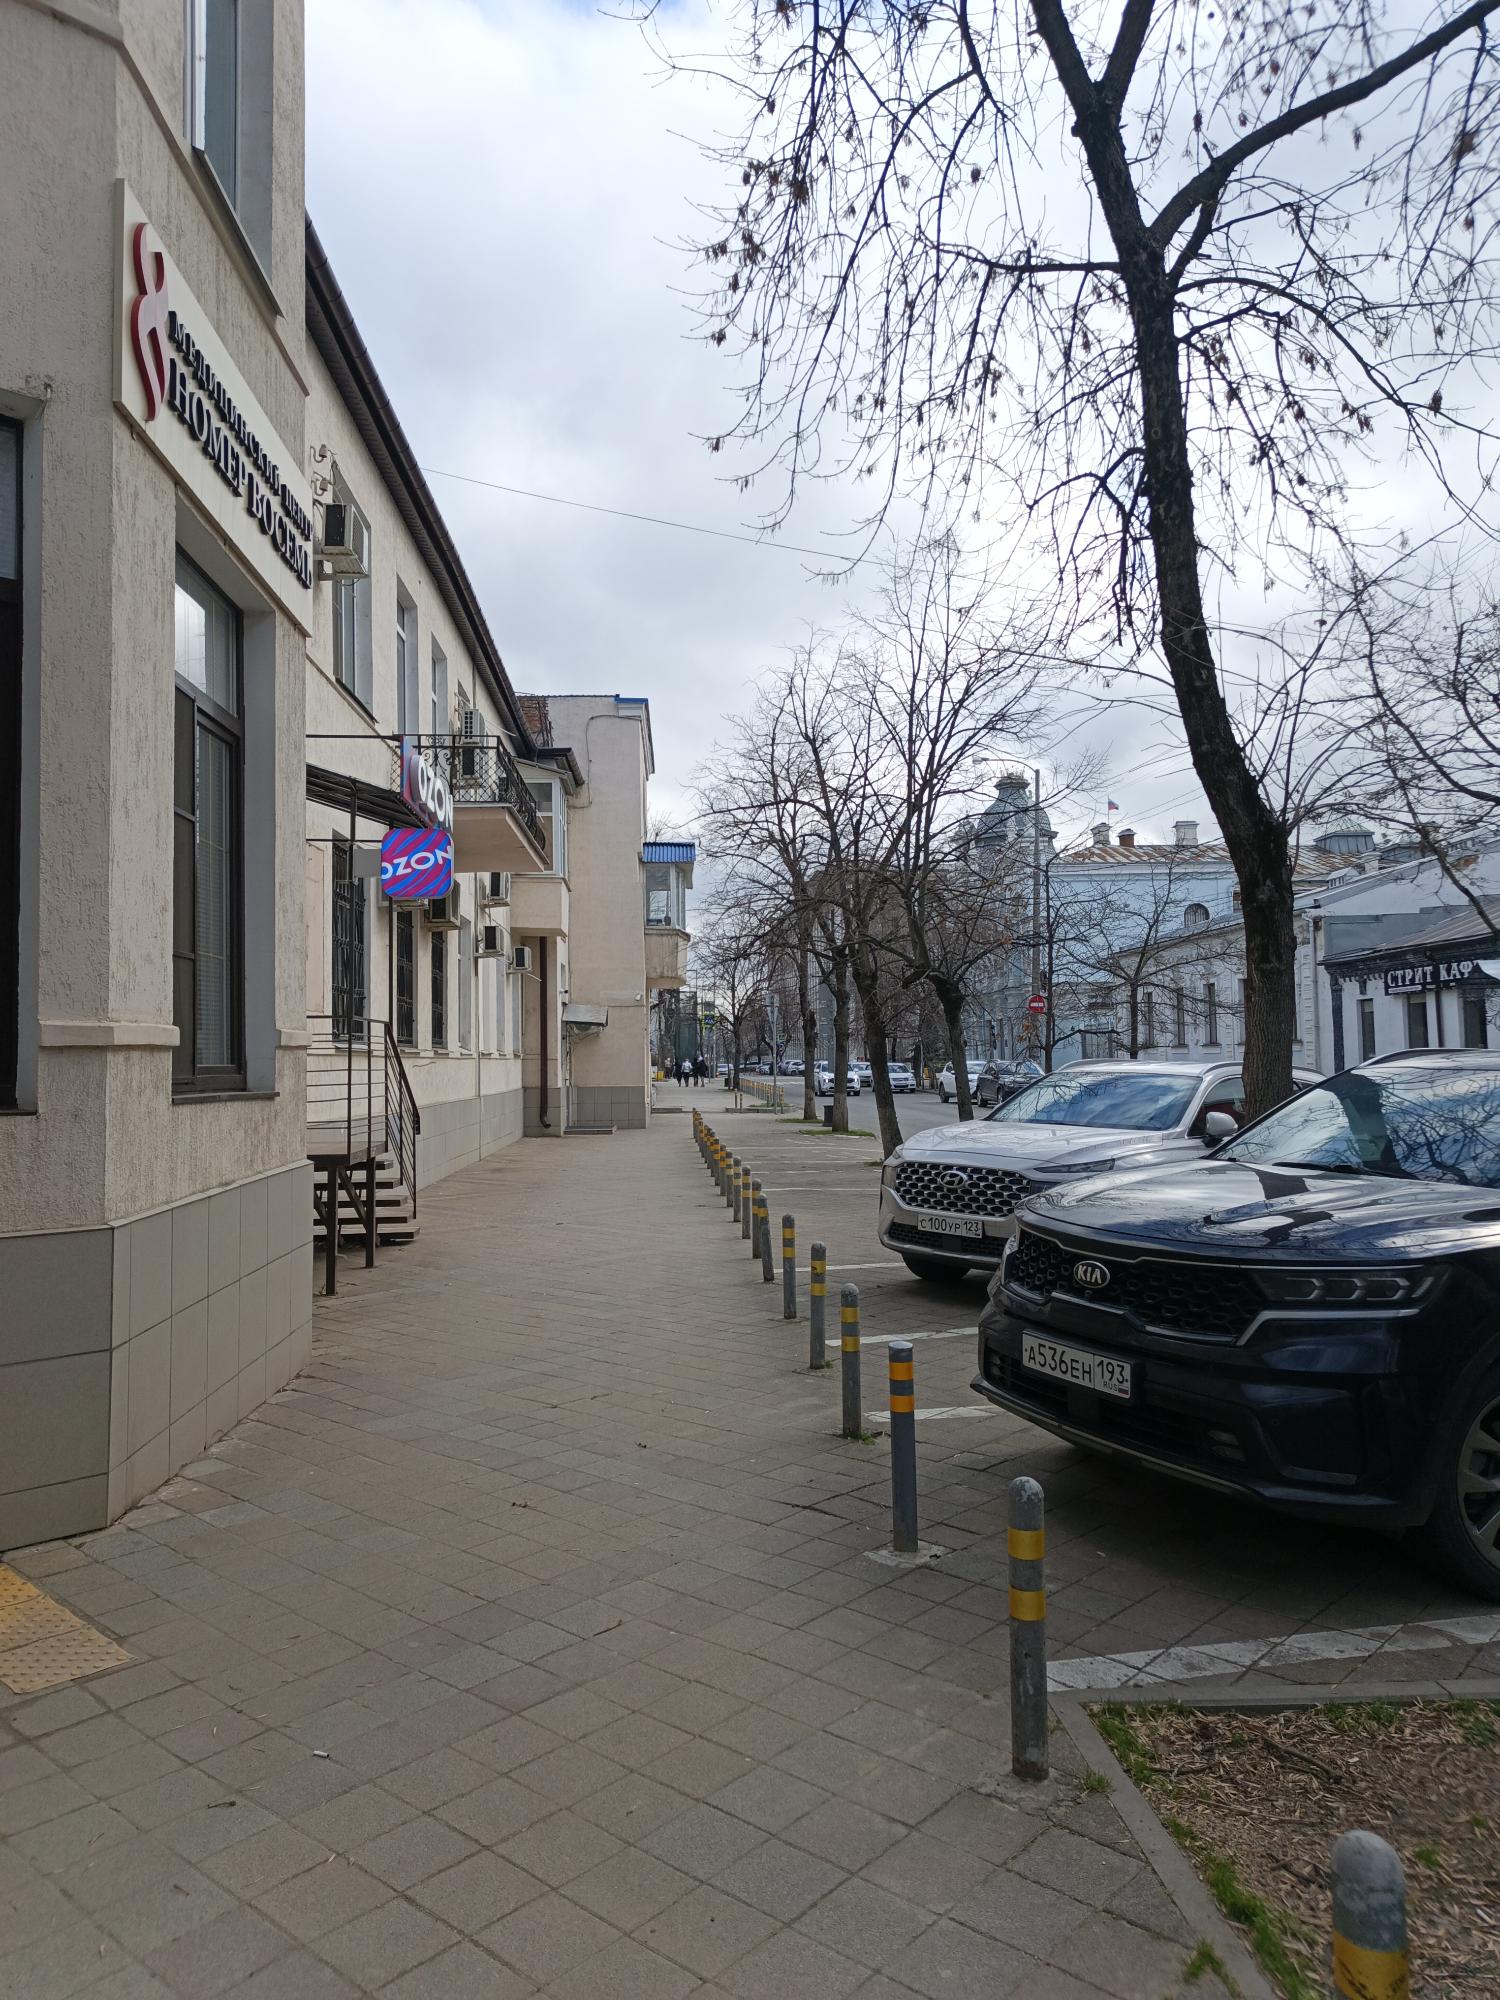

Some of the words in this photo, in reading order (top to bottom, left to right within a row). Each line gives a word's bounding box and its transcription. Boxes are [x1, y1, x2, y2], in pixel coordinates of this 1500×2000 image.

[168, 311, 280, 496] МЕДИЦИНСКИЙ
[280, 483, 312, 541] ЦЕНТР
[169, 357, 246, 497] НОМЕР
[247, 471, 312, 590] ВОСЕМЬ
[418, 754, 453, 832] OZON
[381, 846, 451, 880] OZON
[1387, 966, 1433, 987] СТРИТ
[1439, 960, 1478, 981] КАФ
[1077, 1264, 1102, 1284] KIA
[1028, 1343, 1092, 1383] А536ЕН
[1097, 1360, 1125, 1384] 193
[1103, 1380, 1118, 1392] RUS
